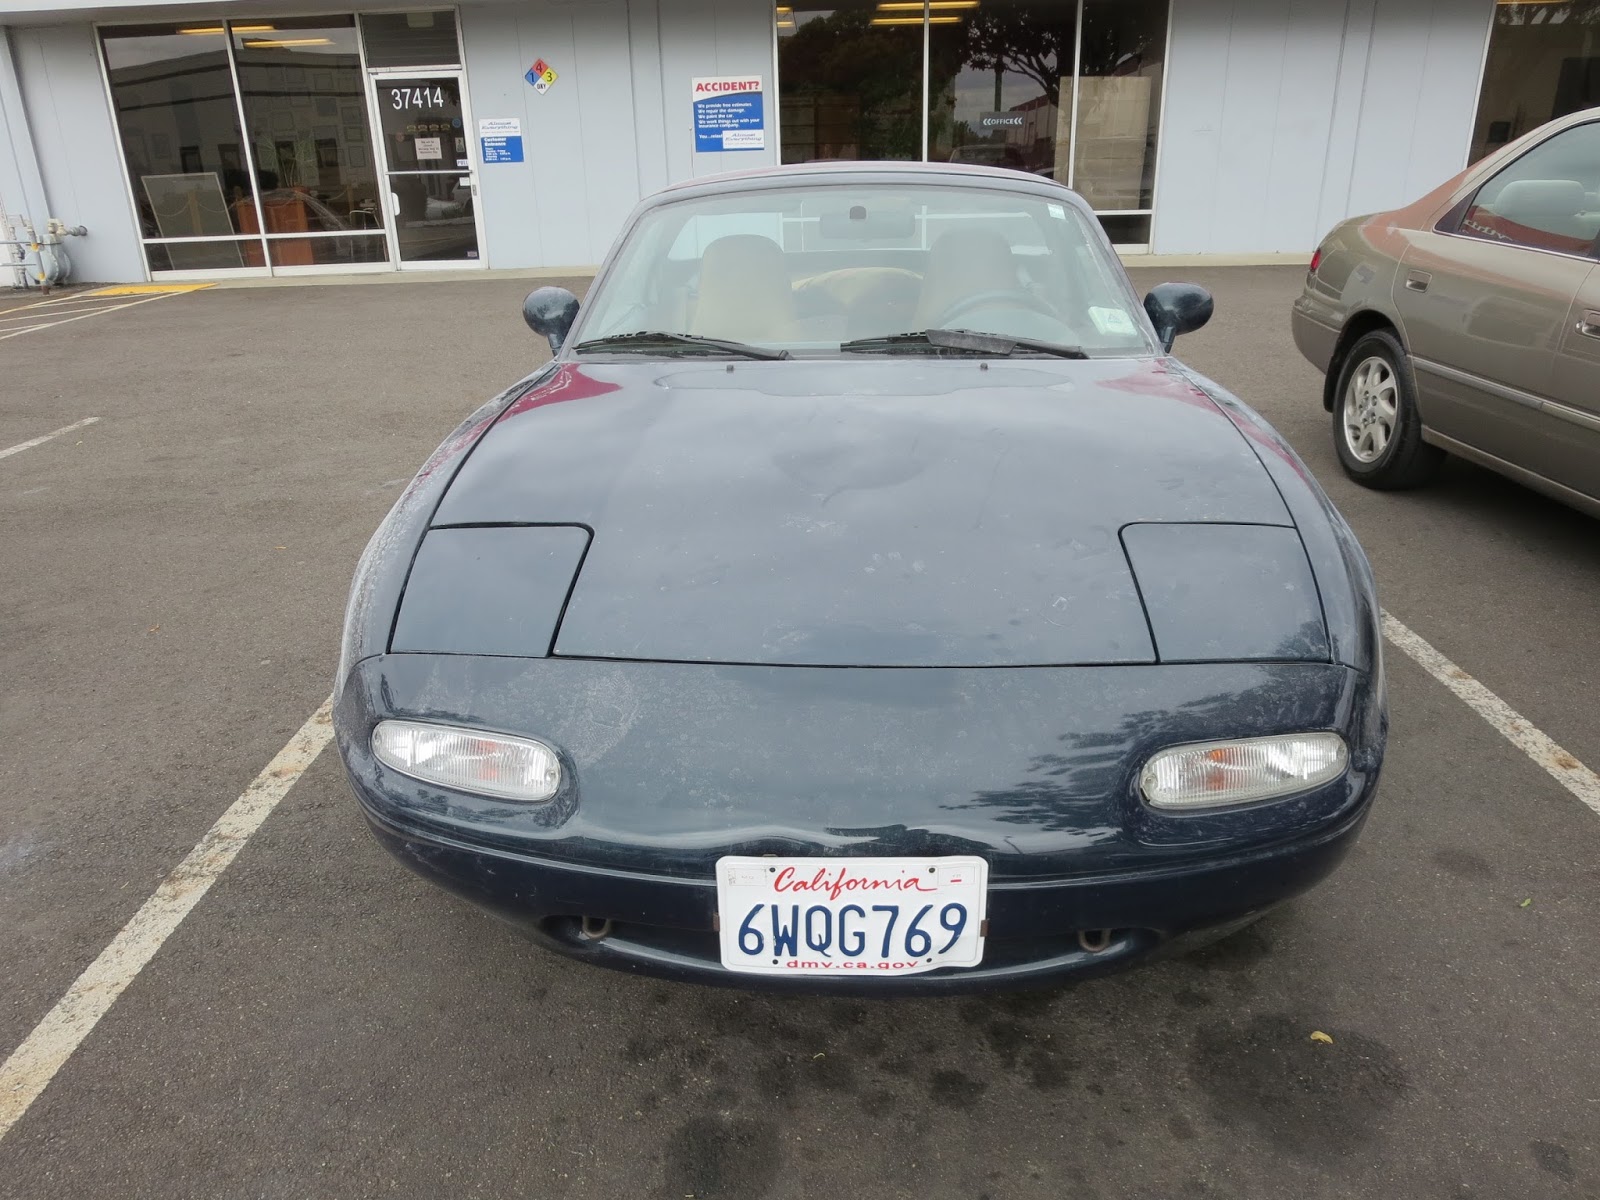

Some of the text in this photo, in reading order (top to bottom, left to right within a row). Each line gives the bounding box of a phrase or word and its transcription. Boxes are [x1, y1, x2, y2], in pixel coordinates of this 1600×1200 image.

[536, 63, 542, 72] 4
[530, 72, 534, 82] 1
[546, 72, 552, 82] 3
[696, 81, 759, 92] ACCIDENT?
[391, 87, 444, 109] 37414
[774, 867, 938, 900] California
[738, 902, 968, 958] 6WQG769
[786, 959, 919, 970] dmv.ca.gov
